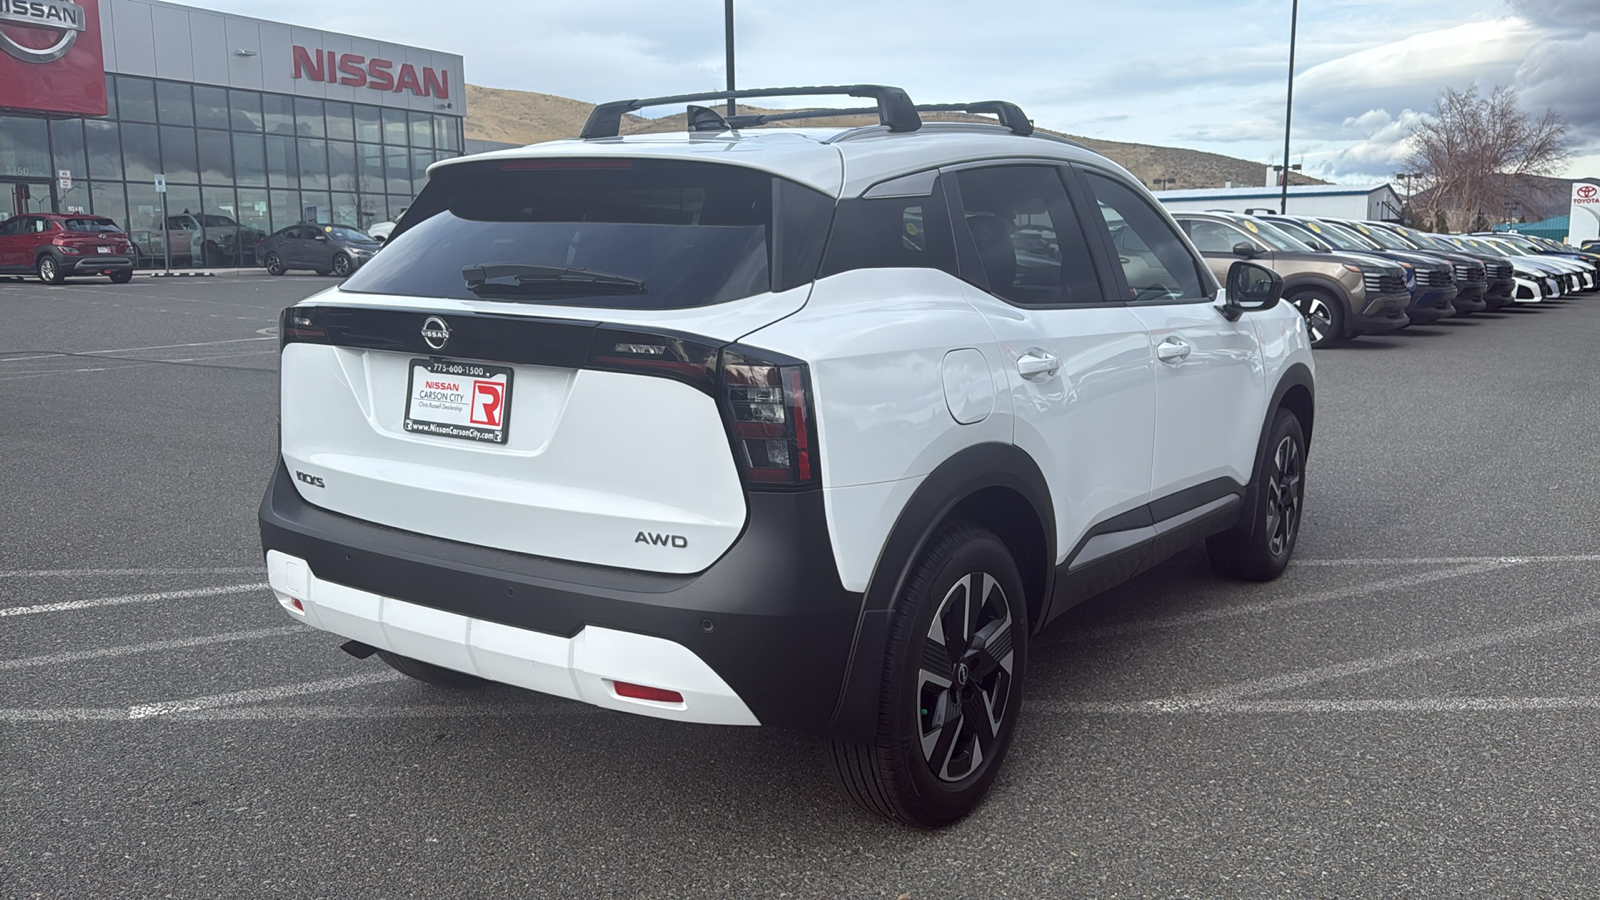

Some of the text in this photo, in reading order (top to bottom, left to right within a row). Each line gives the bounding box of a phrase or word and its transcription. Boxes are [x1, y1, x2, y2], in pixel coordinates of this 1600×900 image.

[0, 0, 77, 24] ISSAN
[293, 45, 449, 99] NISSAN
[433, 363, 484, 376] 775-600-1500
[425, 381, 460, 392] NISSAN
[419, 390, 465, 403] CARSON CITY
[418, 401, 463, 412] Chris Russell Dealership
[413, 423, 494, 440] www.NissanCarsonCity.com
[296, 470, 325, 488] KICKS
[634, 531, 688, 548] AWD
